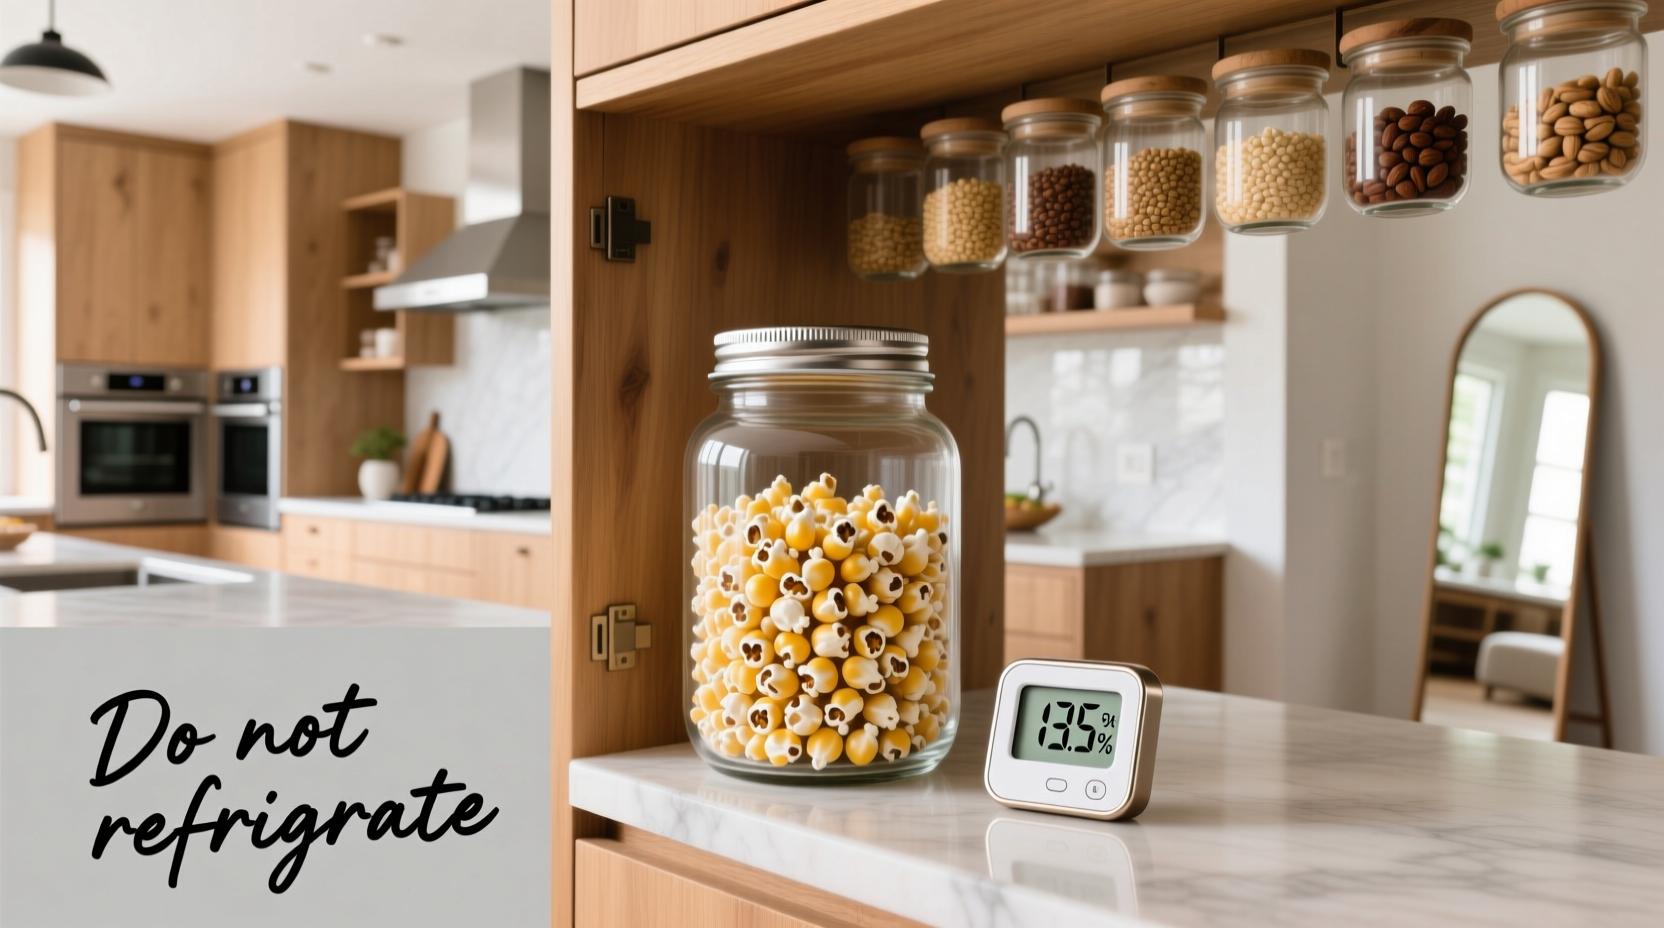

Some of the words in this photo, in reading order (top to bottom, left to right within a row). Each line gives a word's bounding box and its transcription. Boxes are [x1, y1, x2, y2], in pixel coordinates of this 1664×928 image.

[89, 689, 217, 788] Do
[235, 683, 378, 761] not
[91, 768, 500, 895] refrigrate
